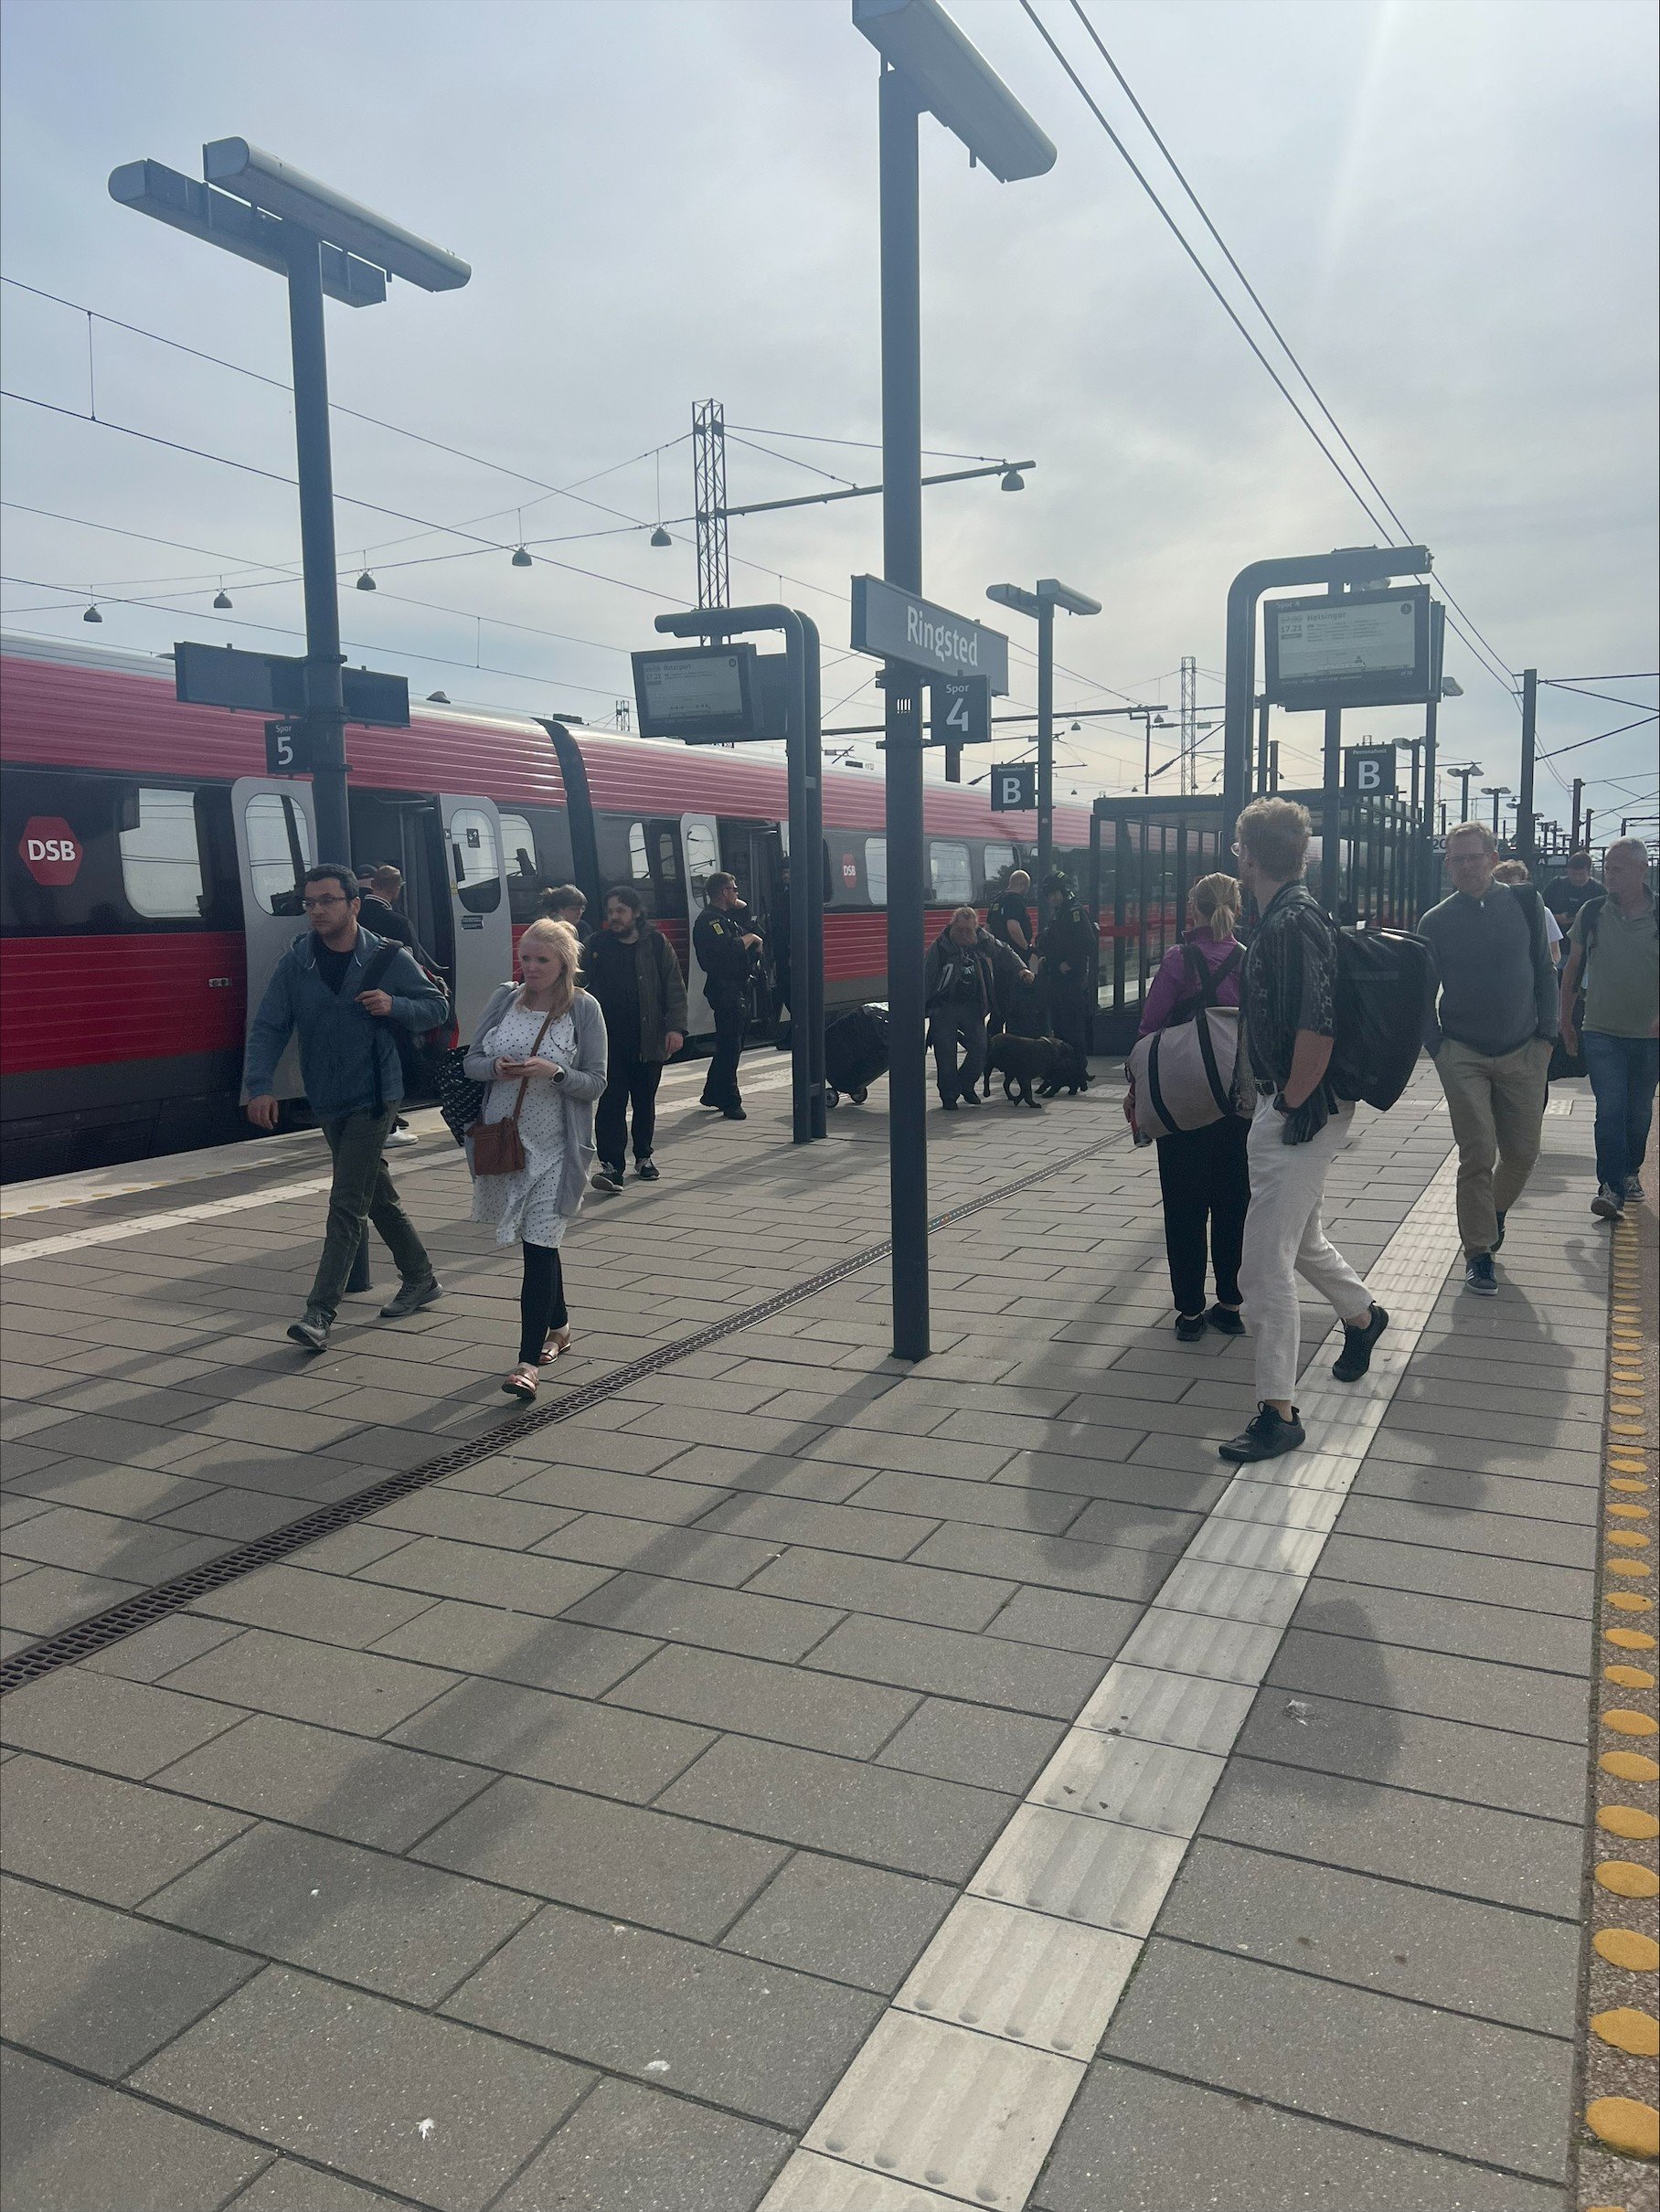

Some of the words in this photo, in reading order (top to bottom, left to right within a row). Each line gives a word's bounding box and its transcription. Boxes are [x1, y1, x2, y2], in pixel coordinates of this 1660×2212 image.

[907, 605, 978, 666] Ringsted
[945, 684, 970, 695] Spor
[946, 697, 969, 732] 4
[275, 725, 292, 733] Spor
[277, 736, 293, 765] 5
[1358, 760, 1380, 790] B
[1003, 777, 1022, 804] B
[27, 839, 76, 861] DSB
[843, 866, 857, 876] DSB
